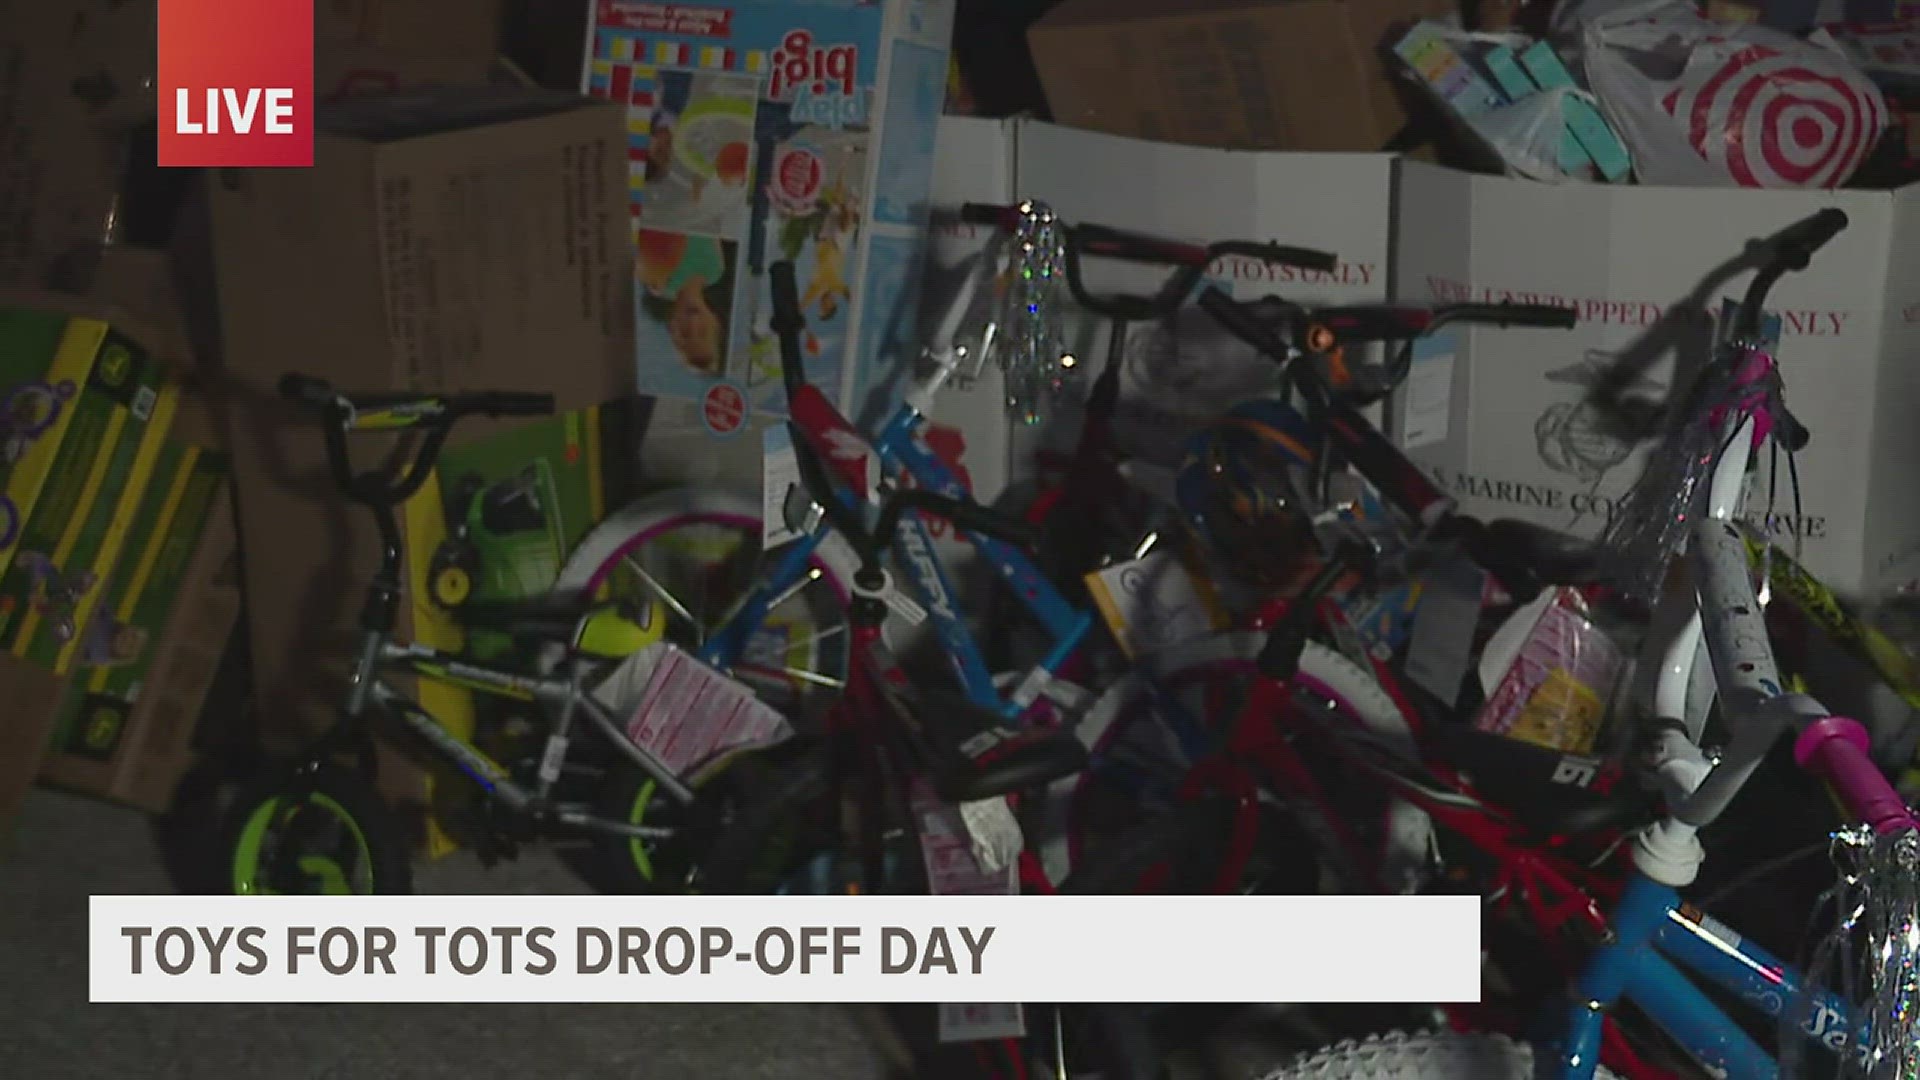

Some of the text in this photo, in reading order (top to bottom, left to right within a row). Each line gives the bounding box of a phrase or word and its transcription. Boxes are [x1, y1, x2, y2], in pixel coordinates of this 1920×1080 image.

[770, 32, 858, 98] big!
[1231, 257, 1295, 282] TOYS
[1776, 310, 1849, 336] NLY
[1454, 473, 1563, 510] MARINE
